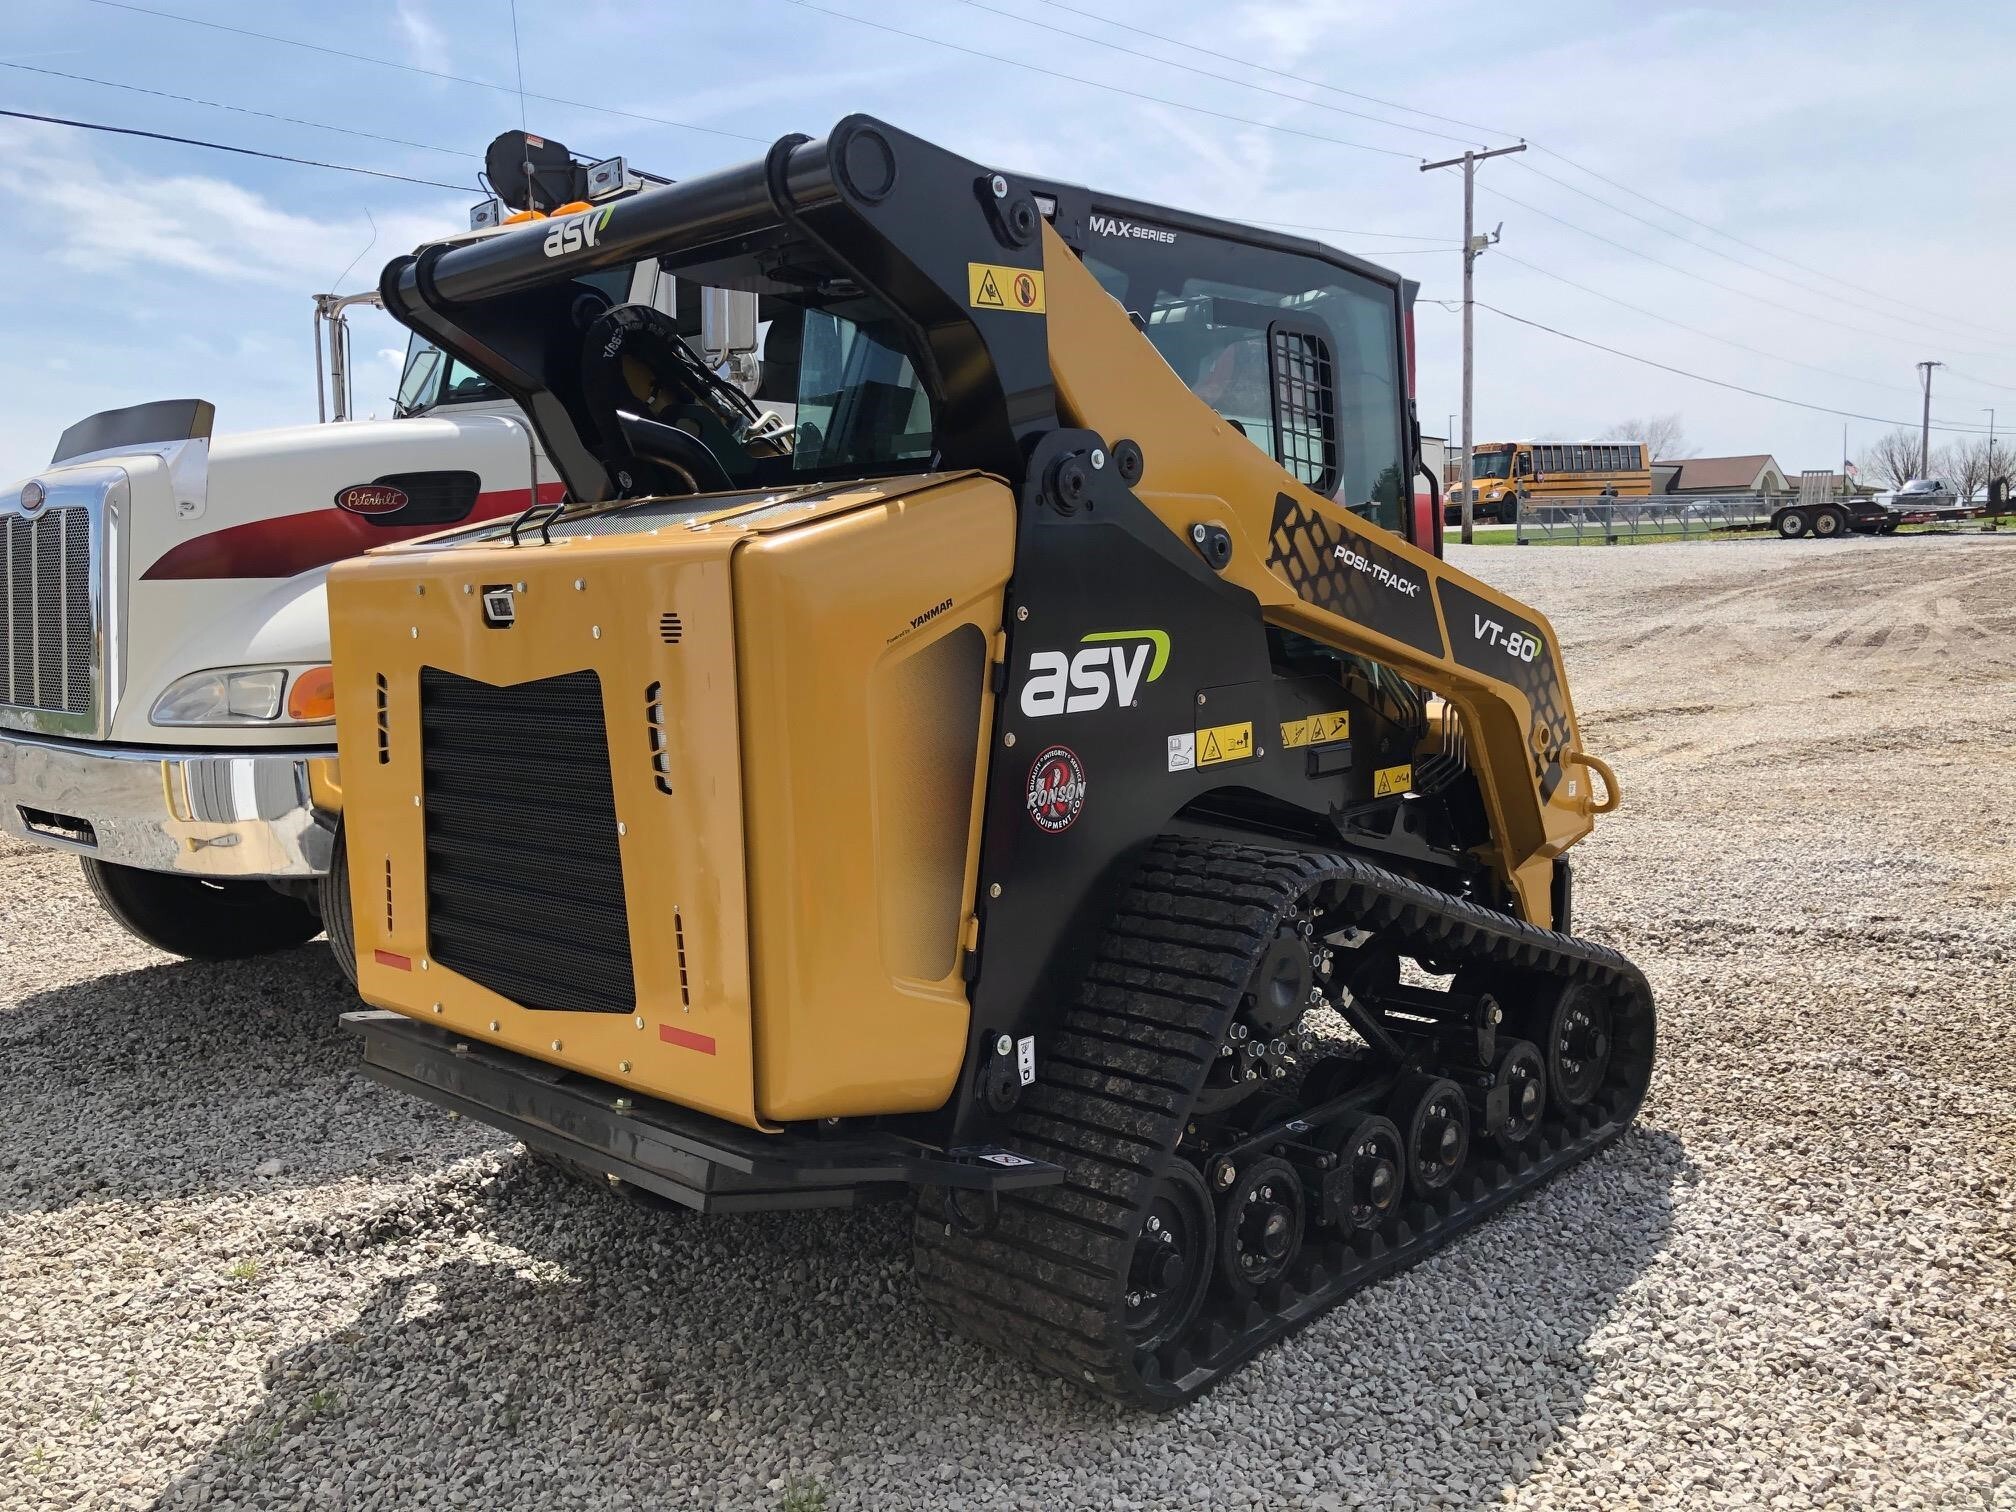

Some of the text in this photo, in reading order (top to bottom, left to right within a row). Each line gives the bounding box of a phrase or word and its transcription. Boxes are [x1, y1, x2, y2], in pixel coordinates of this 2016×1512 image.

[1089, 215, 1174, 244] MAX-SERIES
[347, 490, 402, 507] Peterbilt
[1333, 544, 1418, 598] POSI-TRACK
[910, 597, 953, 630] YANMAR
[1474, 613, 1537, 663] VT-80
[1020, 644, 1151, 718] asv
[1029, 761, 1042, 791] QUALITY
[1043, 749, 1069, 762] INTEGRITY
[1026, 781, 1087, 810] RONSON
[1032, 807, 1072, 830] EQUIPMENT
